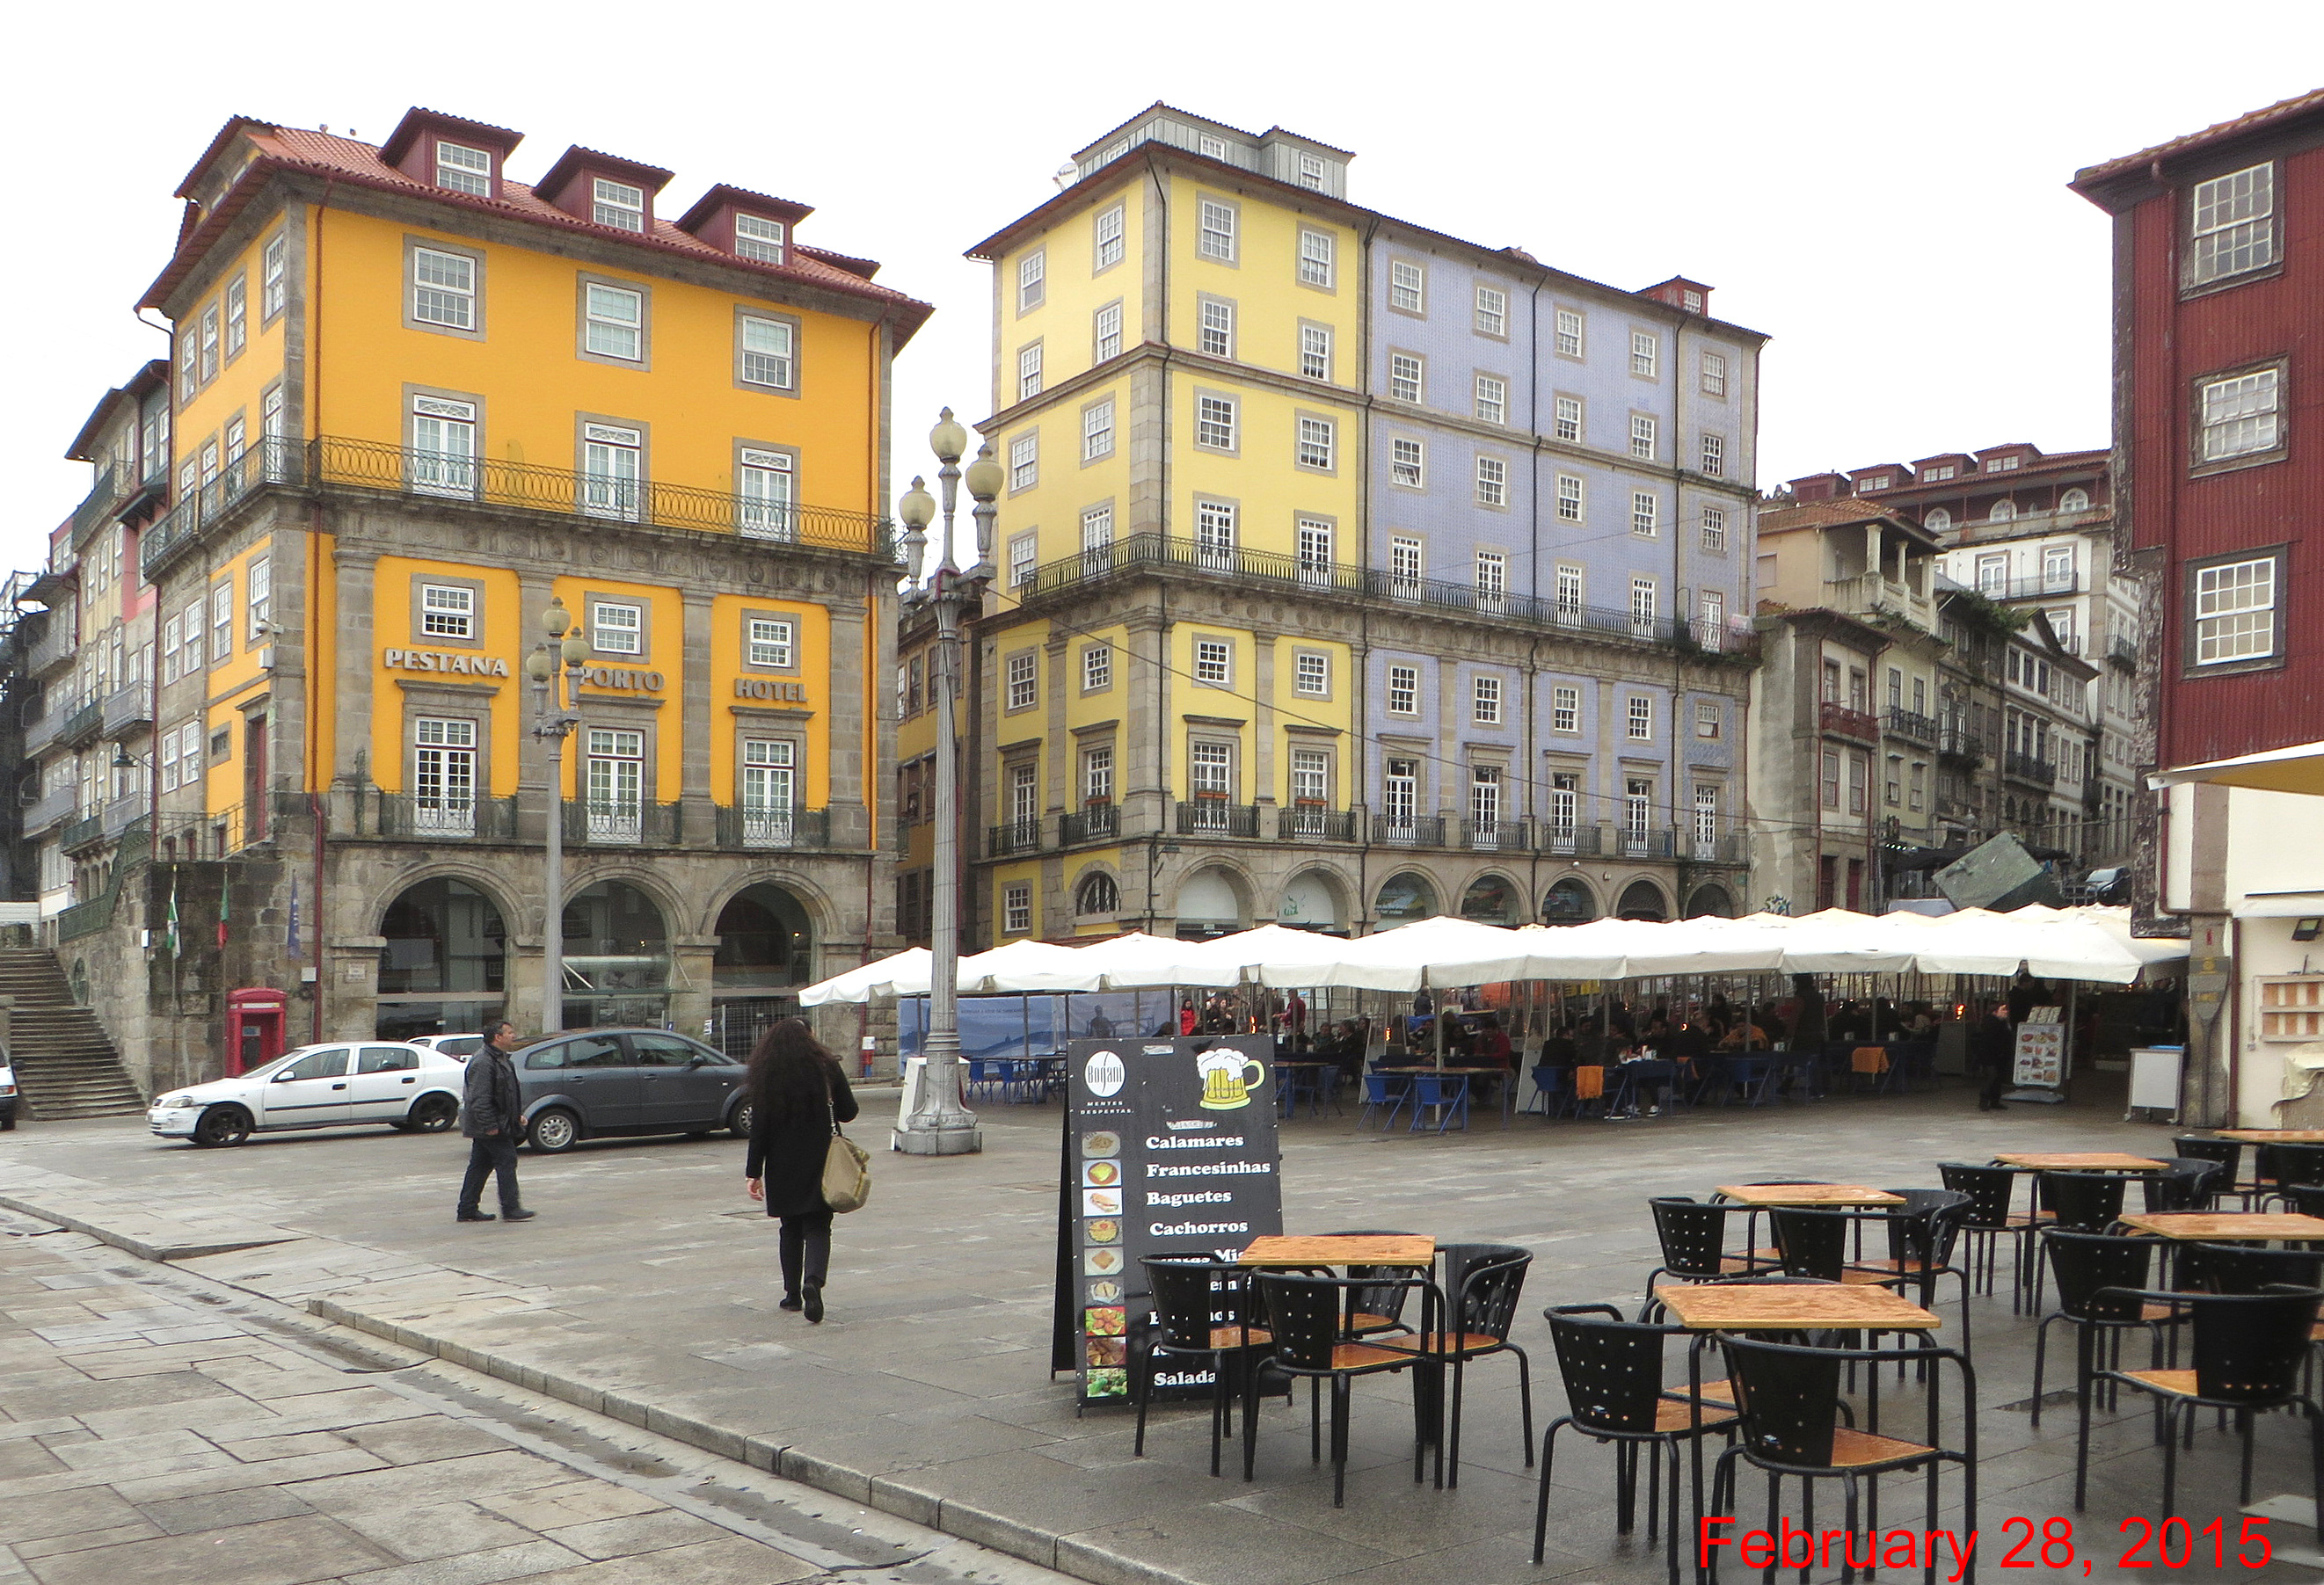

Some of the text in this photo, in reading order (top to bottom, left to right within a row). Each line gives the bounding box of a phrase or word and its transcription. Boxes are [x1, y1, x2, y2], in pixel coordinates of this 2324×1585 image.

[384, 647, 808, 702] PESTANA PORTO HOTEL
[1088, 1064, 1123, 1094] Bogani
[1146, 1135, 1245, 1150] Calamares
[1146, 1160, 1271, 1178] Francesinhas
[1146, 1190, 1233, 1208] Baguetes
[1149, 1221, 1249, 1236] Cachorros
